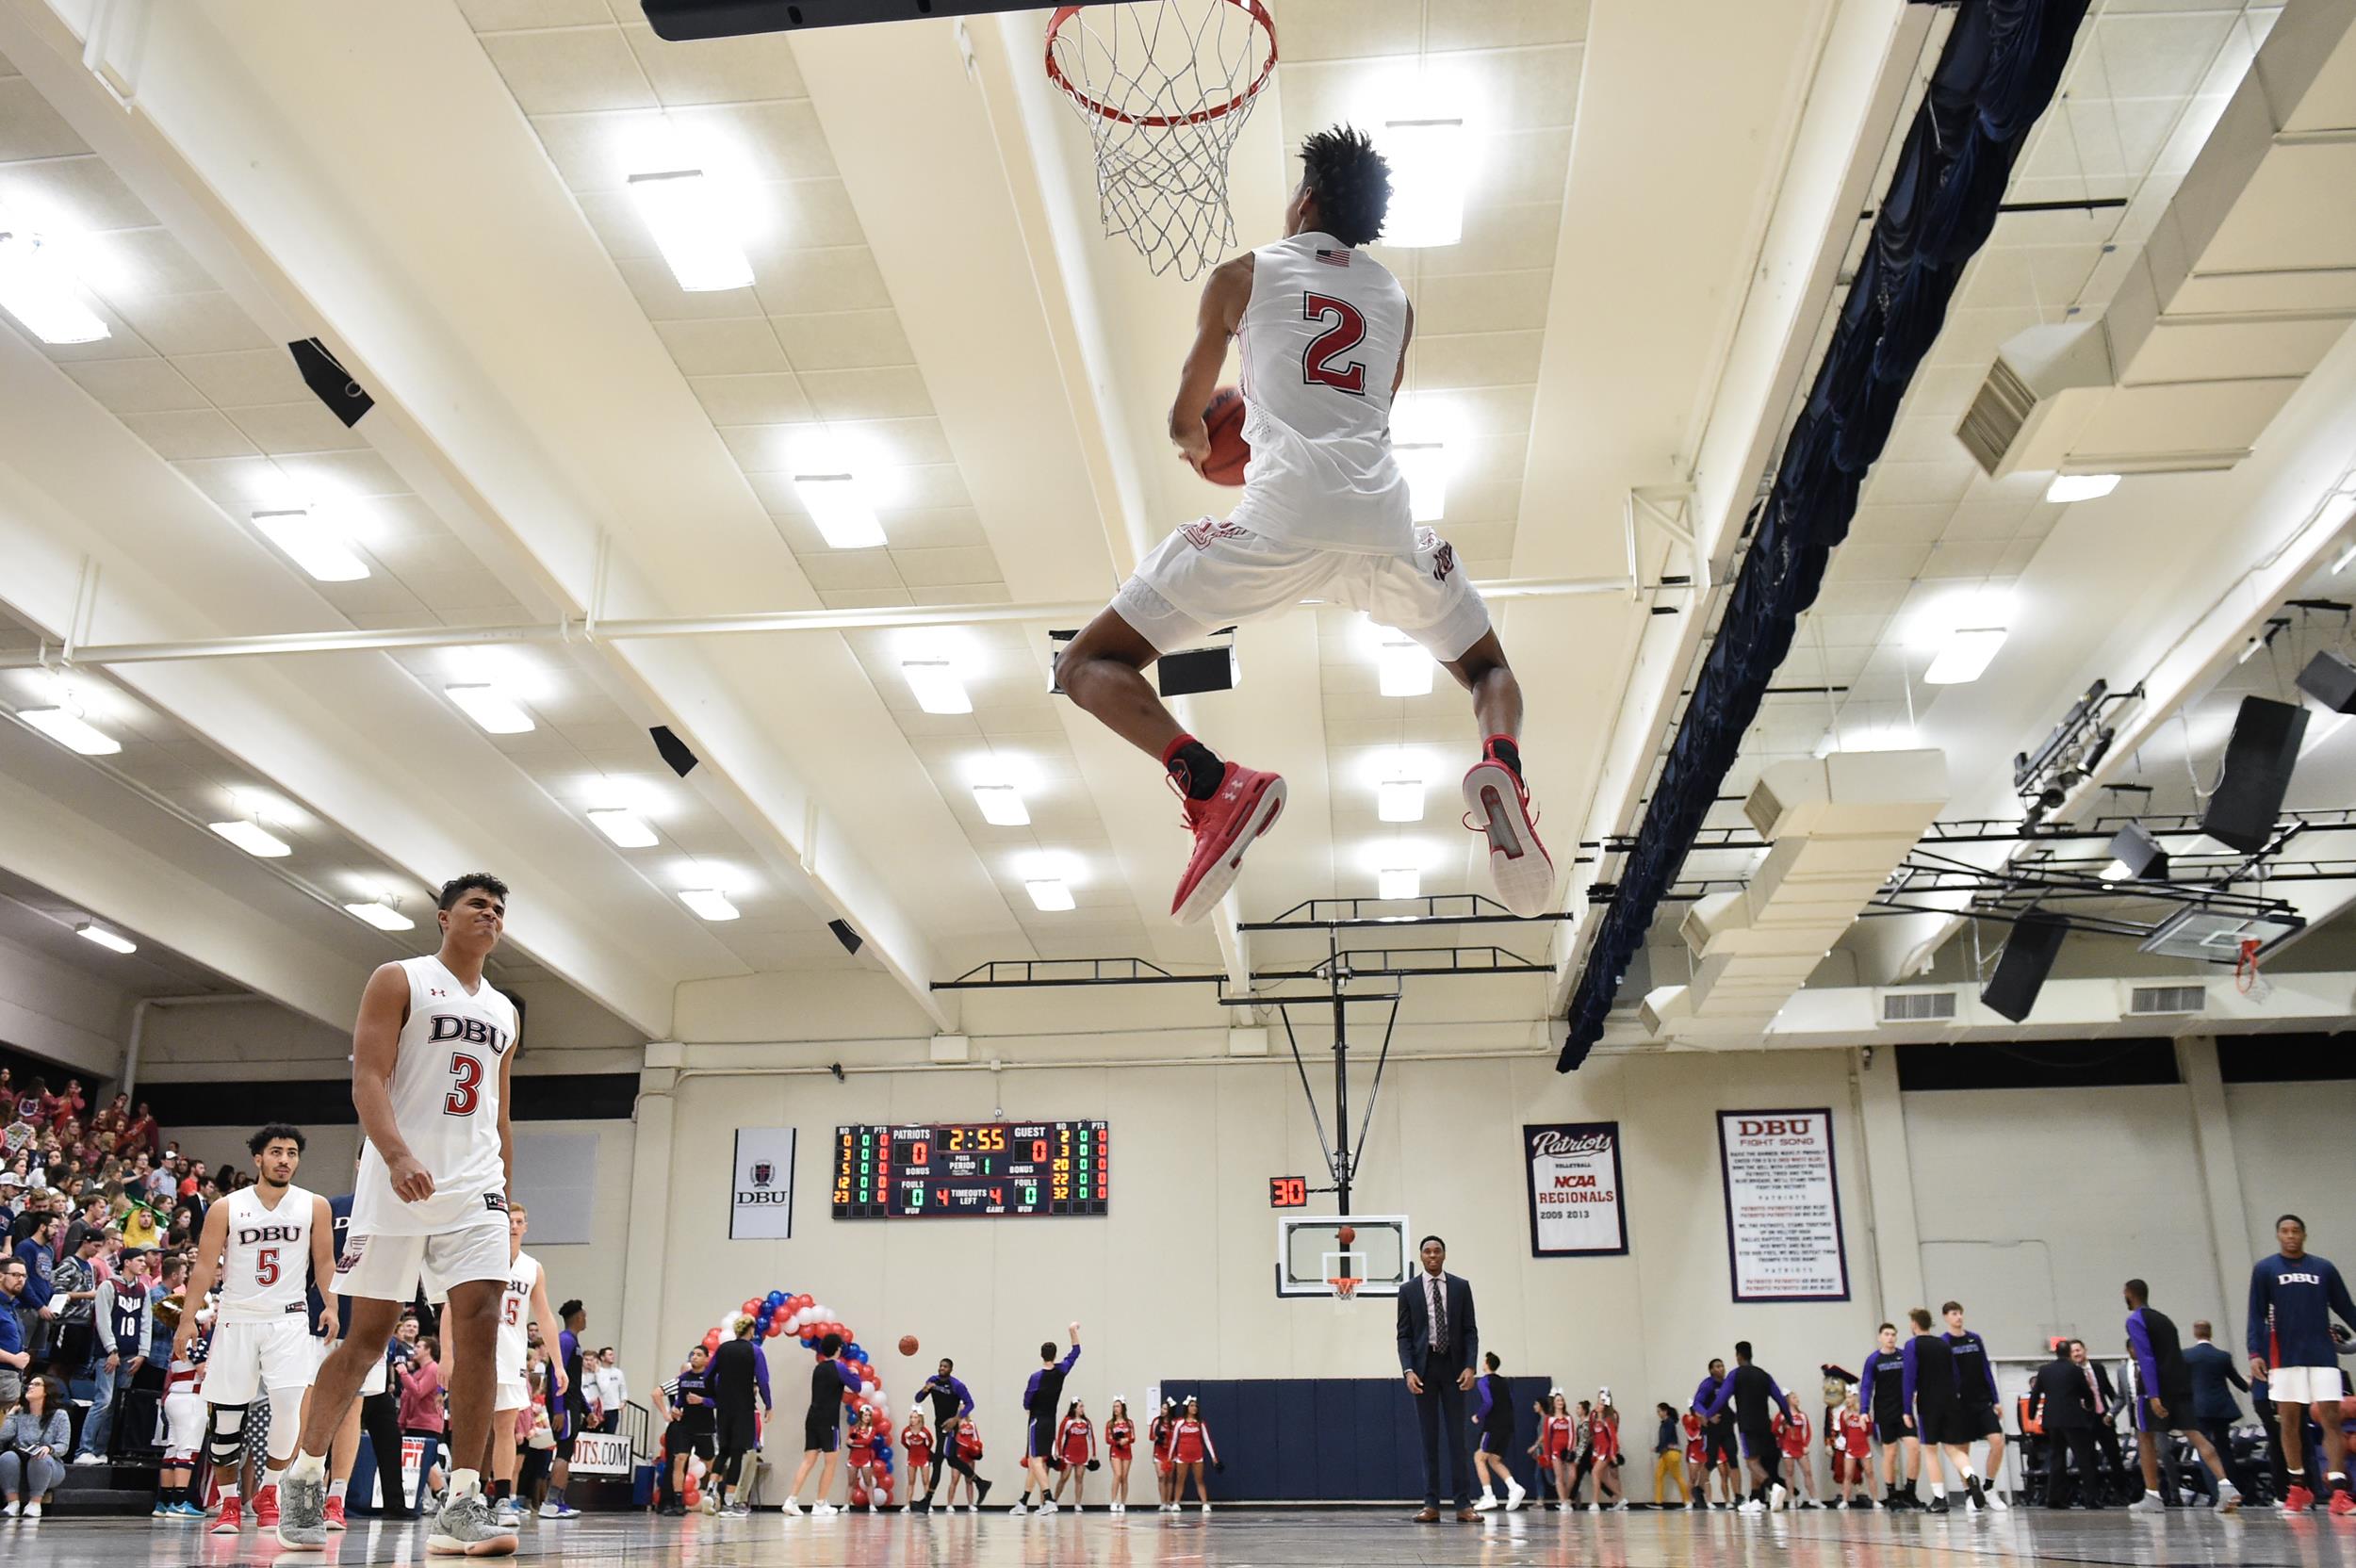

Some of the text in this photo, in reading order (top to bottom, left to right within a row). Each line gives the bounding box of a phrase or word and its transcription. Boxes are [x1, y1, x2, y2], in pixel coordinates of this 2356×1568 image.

[1302, 290, 1366, 397] 2
[428, 1014, 508, 1056] DBU
[444, 1052, 484, 1117] 3
[892, 1129, 930, 1140] PATRIOTS
[1014, 1127, 1046, 1137] GUEST
[1738, 1119, 1812, 1136] DBU
[843, 1134, 889, 1147] 0 0 0
[949, 1128, 1005, 1151] 2:55
[1060, 1130, 1107, 1143] 2 0 0
[1740, 1137, 1815, 1147] FIGHT SONG
[1032, 1139, 1047, 1163] 0
[1061, 1144, 1107, 1156] 3 0 0
[1532, 1131, 1613, 1157] Patriots
[843, 1148, 888, 1160] 3 0 0
[912, 1142, 927, 1165] 0
[842, 1162, 888, 1174] 5 0 0
[949, 1162, 975, 1170] PERIOD
[984, 1157, 990, 1174] 1
[1009, 1166, 1034, 1174] BONUS
[1053, 1158, 1107, 1171] 20 0 0
[906, 1168, 930, 1176] BONUS
[1053, 1172, 1106, 1185] 22 0 0
[838, 1176, 888, 1189] 12 0 0
[1554, 1175, 1596, 1188] NCAA
[737, 1191, 788, 1204] DBU
[833, 1190, 887, 1203] 23 0 0
[911, 1188, 924, 1206] 0
[936, 1188, 950, 1207] 4
[952, 1189, 987, 1198] TIMEOUTS
[990, 1187, 1002, 1205] 4
[1025, 1186, 1037, 1205] 0
[1054, 1186, 1106, 1200] 32 0 0
[1272, 1180, 1305, 1206] 30
[1539, 1190, 1614, 1204] REGIONALS
[959, 1197, 977, 1205] LEFT
[1566, 1210, 1590, 1218] 2013
[238, 1225, 302, 1246] DBU
[255, 1248, 281, 1287] 5
[2278, 1272, 2321, 1285] DBU
[506, 1280, 530, 1296] BU
[503, 1297, 521, 1327] 5
[121, 1316, 136, 1336] 18
[570, 1440, 629, 1466] OTS.COM
